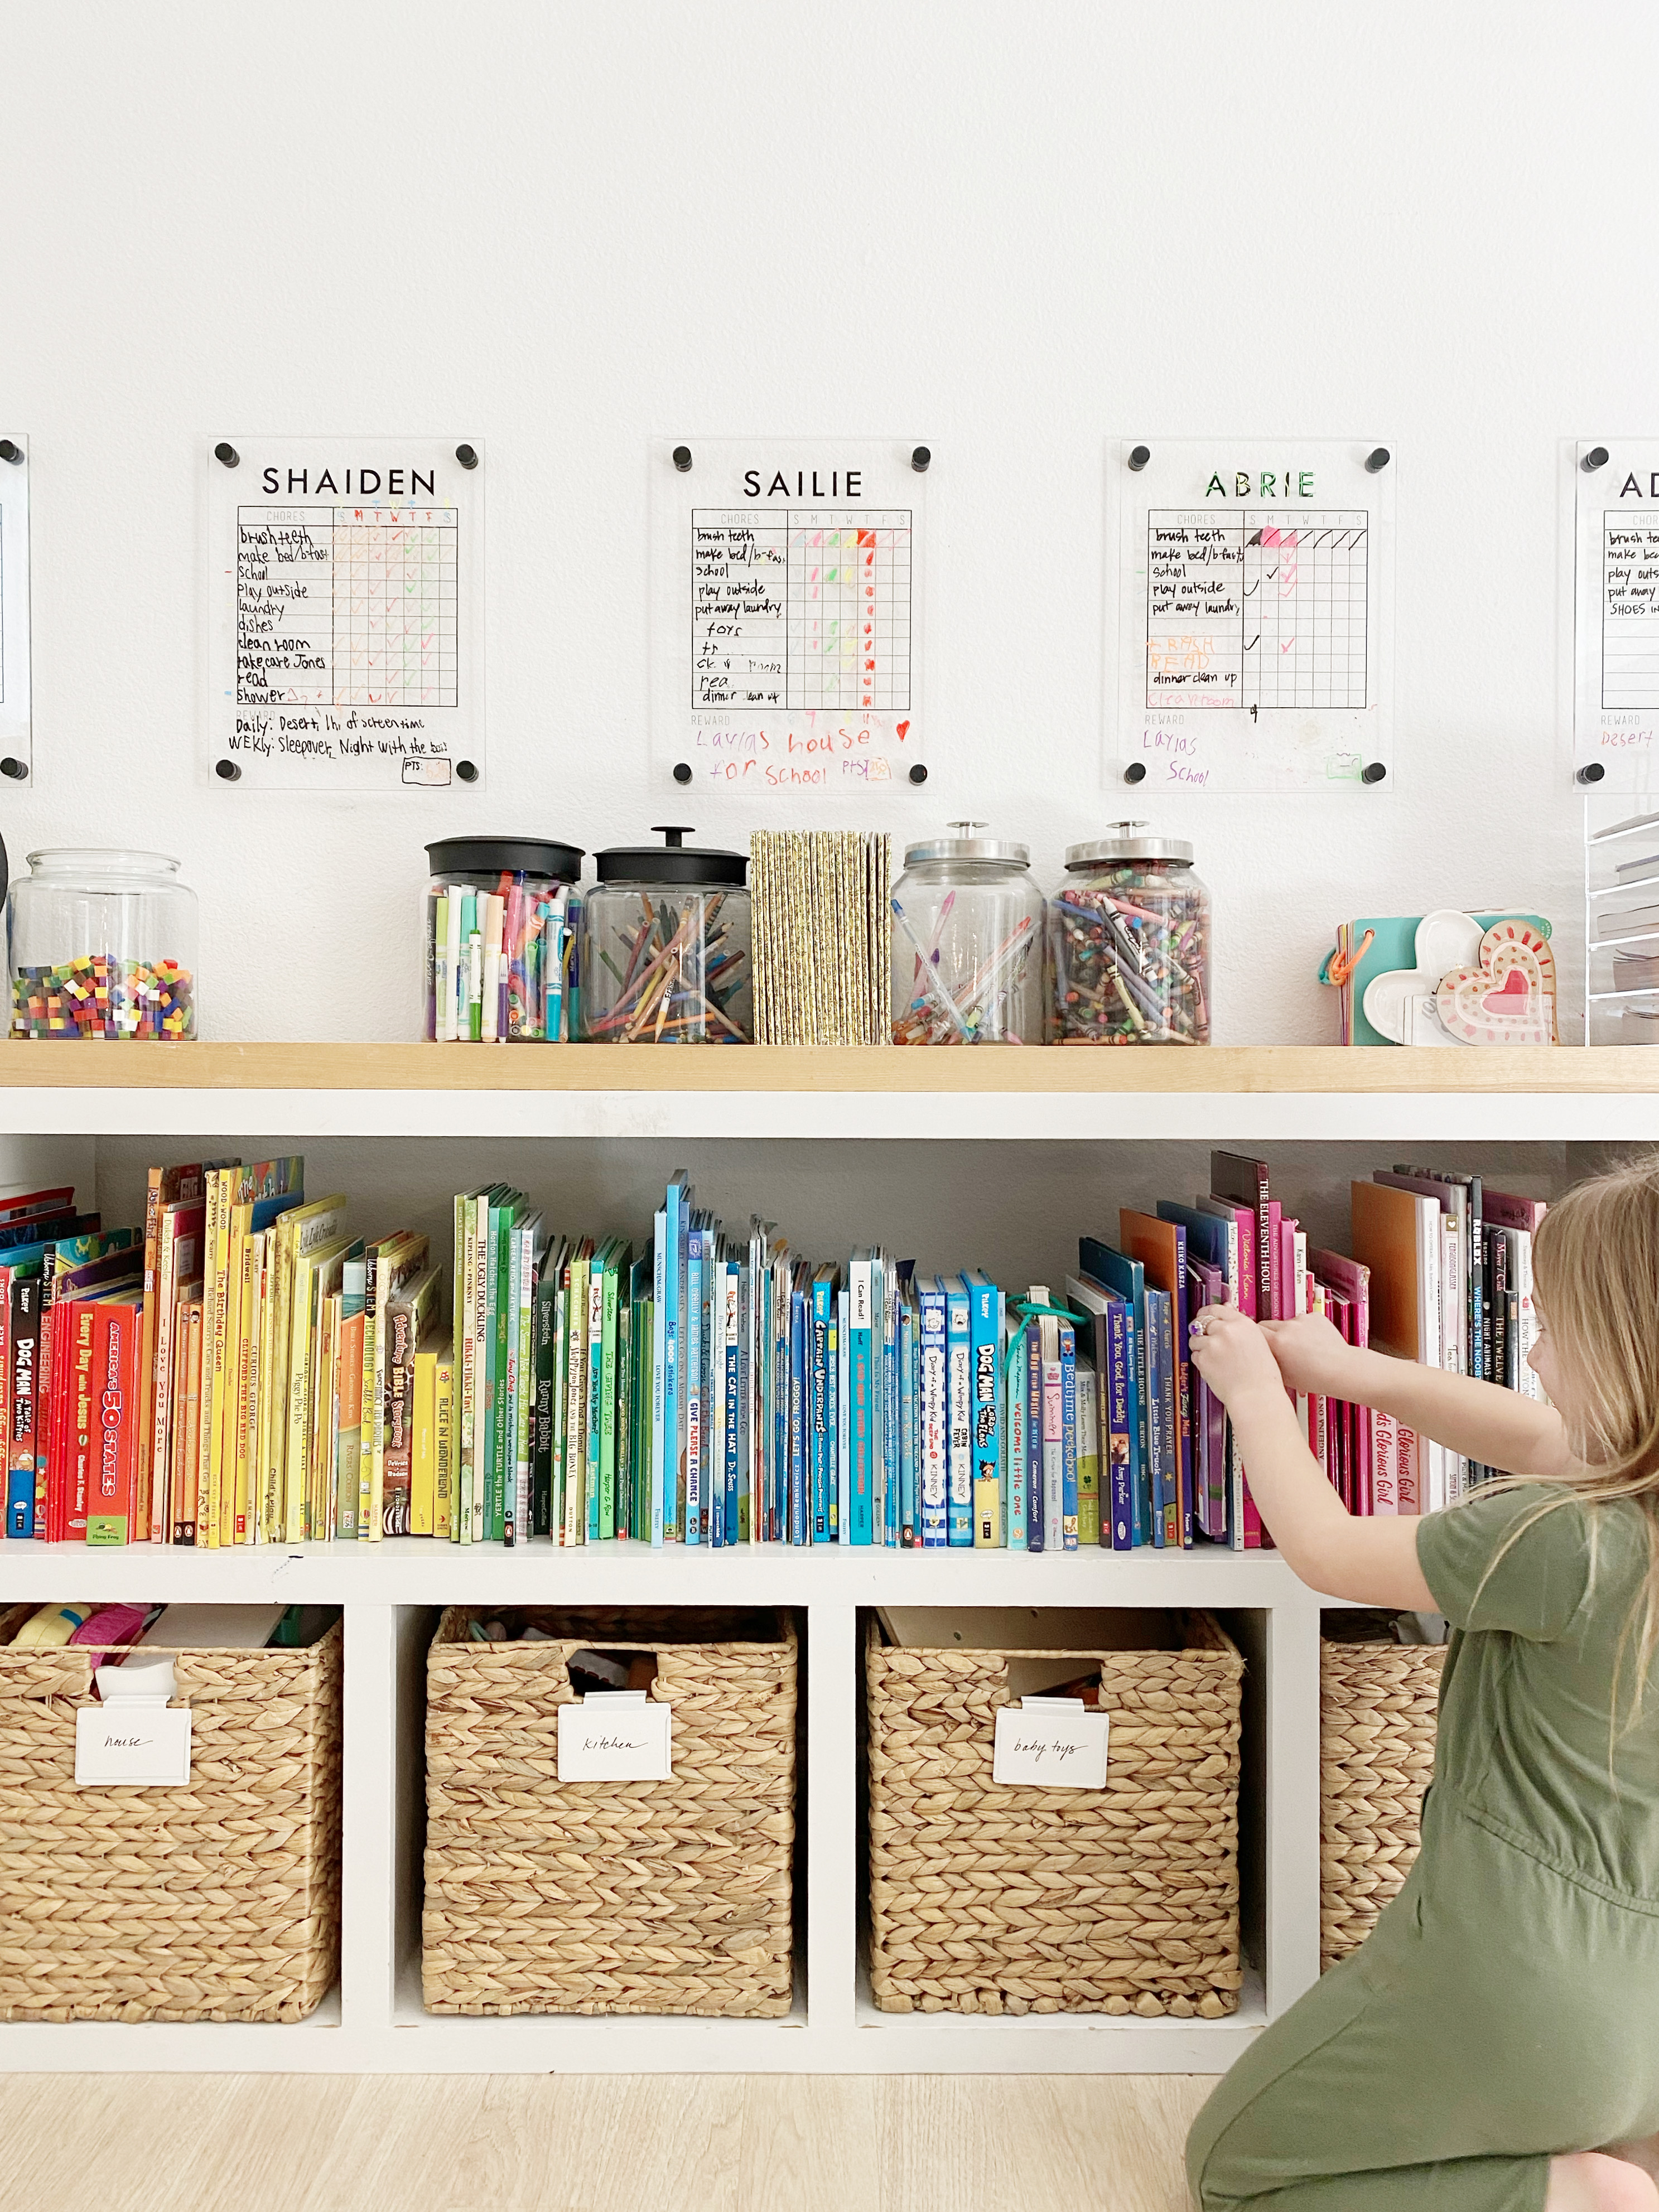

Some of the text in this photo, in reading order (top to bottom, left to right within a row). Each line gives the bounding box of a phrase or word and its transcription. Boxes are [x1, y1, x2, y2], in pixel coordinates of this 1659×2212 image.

[262, 467, 435, 496] SHAIDEN
[743, 470, 862, 497] SAILIE
[1205, 472, 1315, 498] ABRIE
[266, 511, 305, 521] CHORES
[721, 514, 759, 524] CHORES
[1177, 514, 1216, 525] CHORES
[240, 525, 313, 547] brush teeth
[697, 528, 754, 542] brush teeth
[1156, 528, 1226, 543] brush teeth
[1609, 532, 1642, 545] brush
[238, 545, 270, 563] make
[696, 548, 723, 561] make
[1151, 547, 1181, 561] make
[1608, 549, 1636, 559] make
[696, 563, 729, 578] school
[1608, 567, 1631, 586] play
[699, 579, 765, 602] play outside
[1153, 581, 1225, 598] play outside
[1608, 586, 1656, 602] put away
[239, 598, 285, 621] laundry
[695, 603, 714, 621] put
[715, 603, 740, 620] away
[1152, 601, 1174, 616] put
[1610, 603, 1646, 616] SHOES
[239, 614, 273, 633] dishes
[238, 633, 311, 652] clean room
[264, 654, 326, 669] care Jones
[238, 668, 268, 688] read
[1154, 672, 1237, 688] dinner clean up
[236, 710, 276, 721] REWARD
[691, 715, 730, 726] REWARD
[1145, 714, 1184, 725] REWARD
[1601, 715, 1641, 726] REWARD
[340, 738, 374, 757] Night
[409, 737, 427, 754] the
[788, 728, 871, 754] house
[1260, 1179, 1270, 1292] THE ELEVENTH HOUR
[1242, 1229, 1251, 1300] Victoria Kann
[476, 1239, 486, 1342] THE UGLY DUCKLING
[486, 1301, 496, 1316] Egg
[214, 1270, 225, 1372] The Birthday Queen
[541, 1301, 551, 1345] Silverstein
[364, 1320, 375, 1373] TECHNOLOGY
[1495, 1316, 1504, 1381] THE TWELVE
[16, 1339, 34, 1394] DOG MAN
[76, 1313, 93, 1429] Every Day with Jesus
[728, 1355, 736, 1373] THE
[928, 1356, 937, 1375] Diary
[978, 1343, 996, 1402] DOG MAN
[293, 1373, 303, 1396] Piggy
[393, 1366, 403, 1398] BIBLE
[728, 1377, 736, 1395] CAT
[102, 1321, 122, 1496] AMERICA'S 50 STATES
[728, 1399, 736, 1409] IN
[814, 1368, 827, 1434] UNDERPANTS
[537, 1380, 551, 1453] Runny Babbit
[690, 1403, 698, 1422] GIVE
[1047, 1393, 1060, 1435] Summer
[1062, 1364, 1076, 1482] Bedtime peekaboo!
[690, 1426, 698, 1456] PLEASE
[727, 1433, 736, 1453] HAT
[727, 1461, 736, 1472] Dr.
[1014, 1457, 1023, 1490] little
[1376, 1430, 1393, 1505] Glorious Girl
[1397, 1429, 1415, 1504] Glorious Girl
[727, 1473, 736, 1491] Seuss
[1014, 1737, 1089, 1762] baby toys
